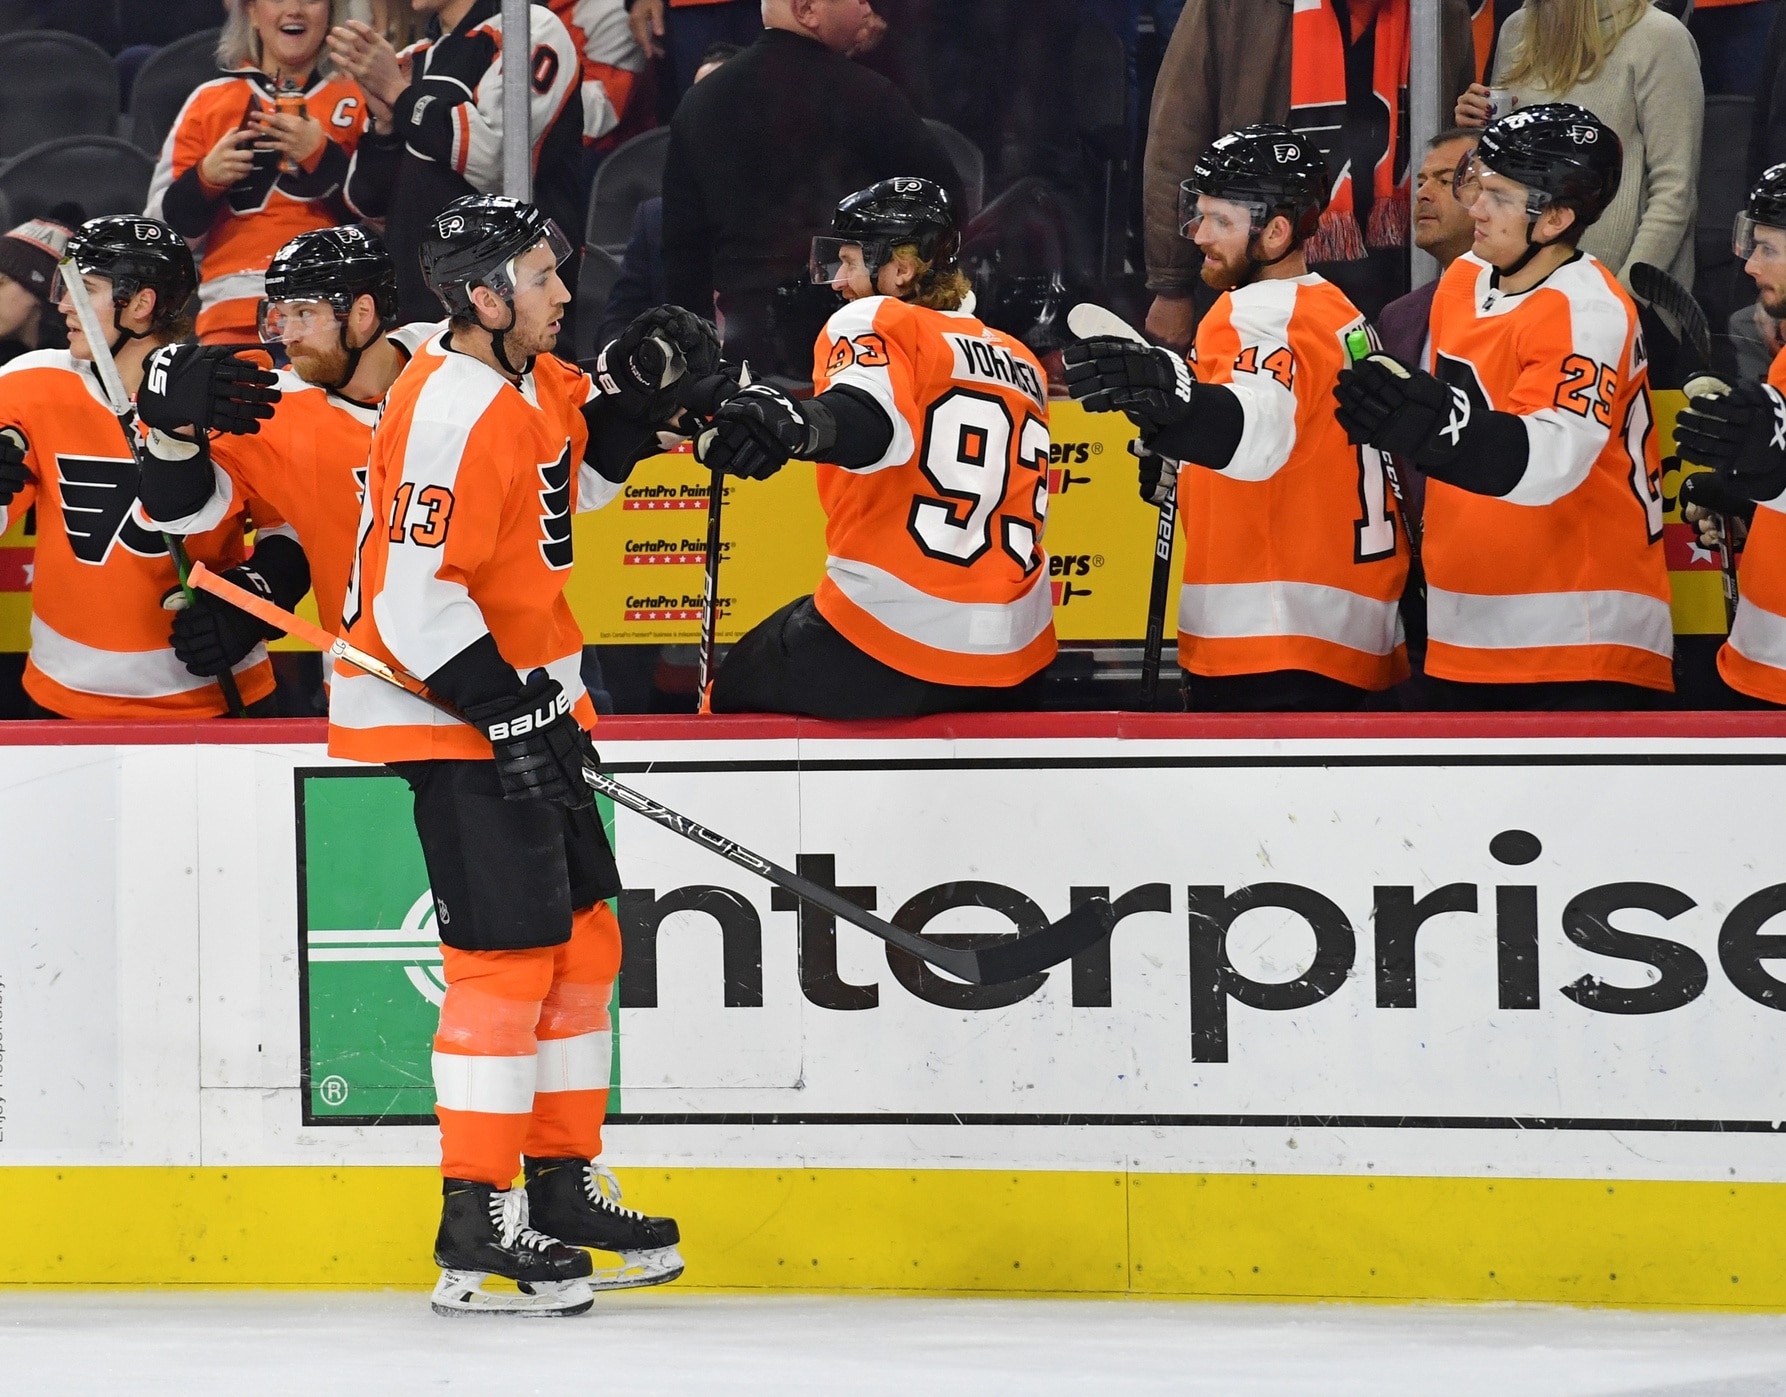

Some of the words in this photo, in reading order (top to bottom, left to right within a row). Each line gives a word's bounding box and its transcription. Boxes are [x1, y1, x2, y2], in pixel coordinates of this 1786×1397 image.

[330, 96, 358, 128] C
[825, 335, 891, 378] 93
[1233, 345, 1295, 392] 14
[1553, 352, 1618, 430] 25
[625, 485, 677, 498] CertaPro
[906, 385, 1051, 579] 93
[1381, 450, 1404, 501] CCM
[388, 481, 456, 549] 13
[625, 539, 677, 553] CertaPro
[626, 595, 678, 609] CertaPro
[488, 689, 570, 742] BAUE
